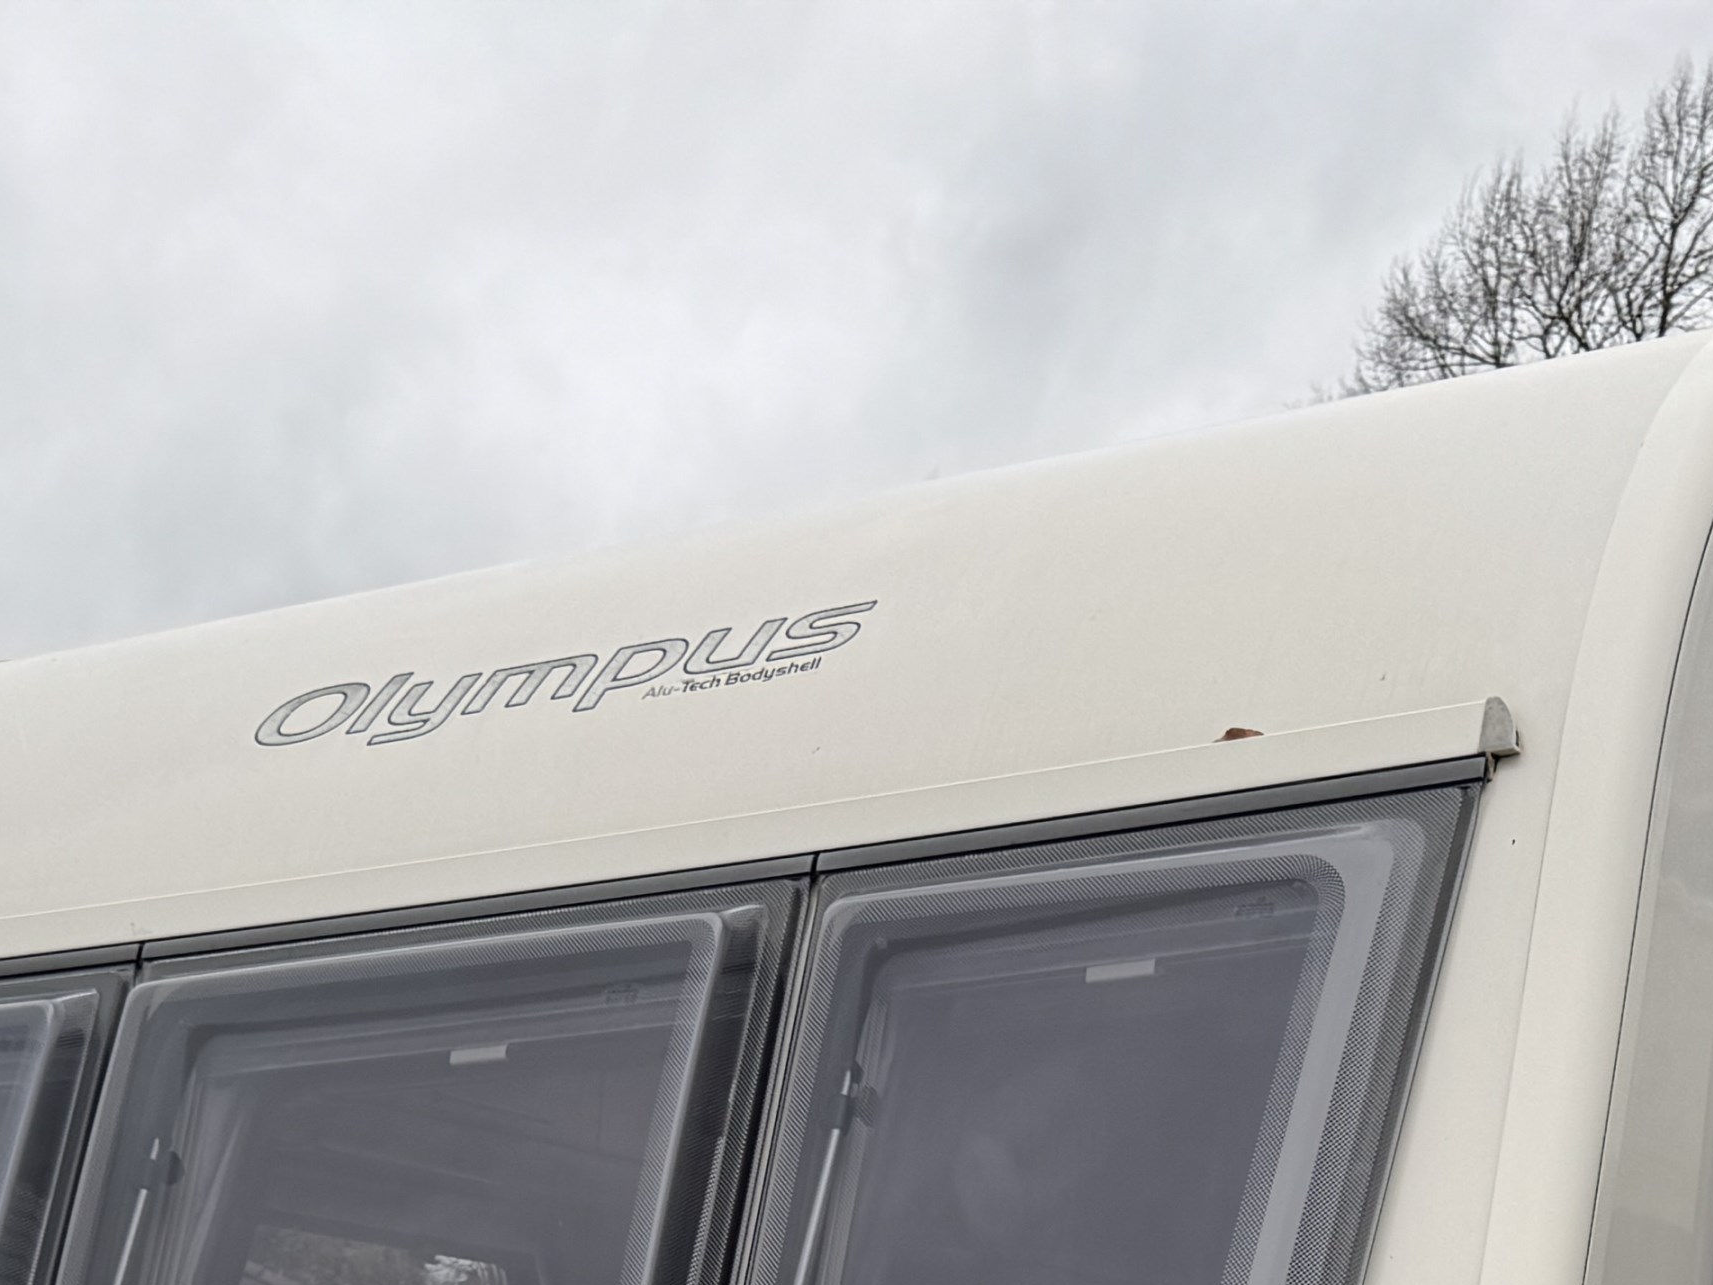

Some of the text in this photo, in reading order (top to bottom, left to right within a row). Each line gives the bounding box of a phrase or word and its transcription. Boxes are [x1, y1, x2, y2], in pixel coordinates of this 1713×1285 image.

[254, 600, 878, 746] Olympus
[641, 657, 823, 699] Alu-Tech Bodyshell
